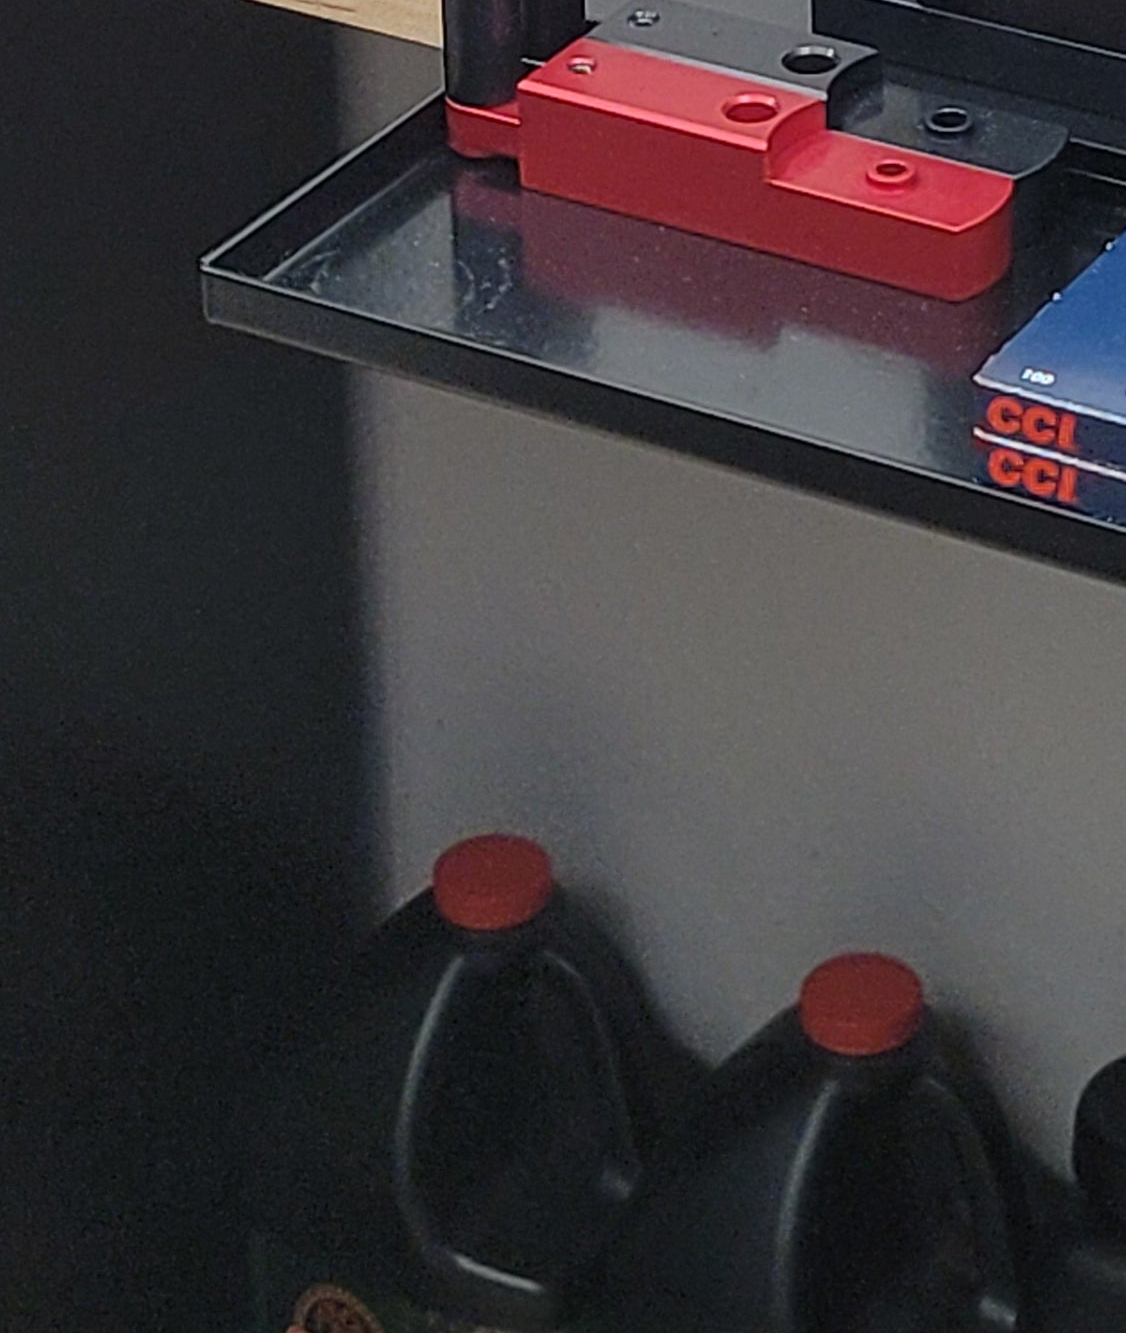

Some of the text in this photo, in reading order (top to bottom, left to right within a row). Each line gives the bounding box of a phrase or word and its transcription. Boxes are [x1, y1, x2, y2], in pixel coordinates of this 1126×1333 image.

[1021, 368, 1056, 385] 100
[986, 395, 1077, 451] CCI
[987, 447, 1078, 504] CCI
